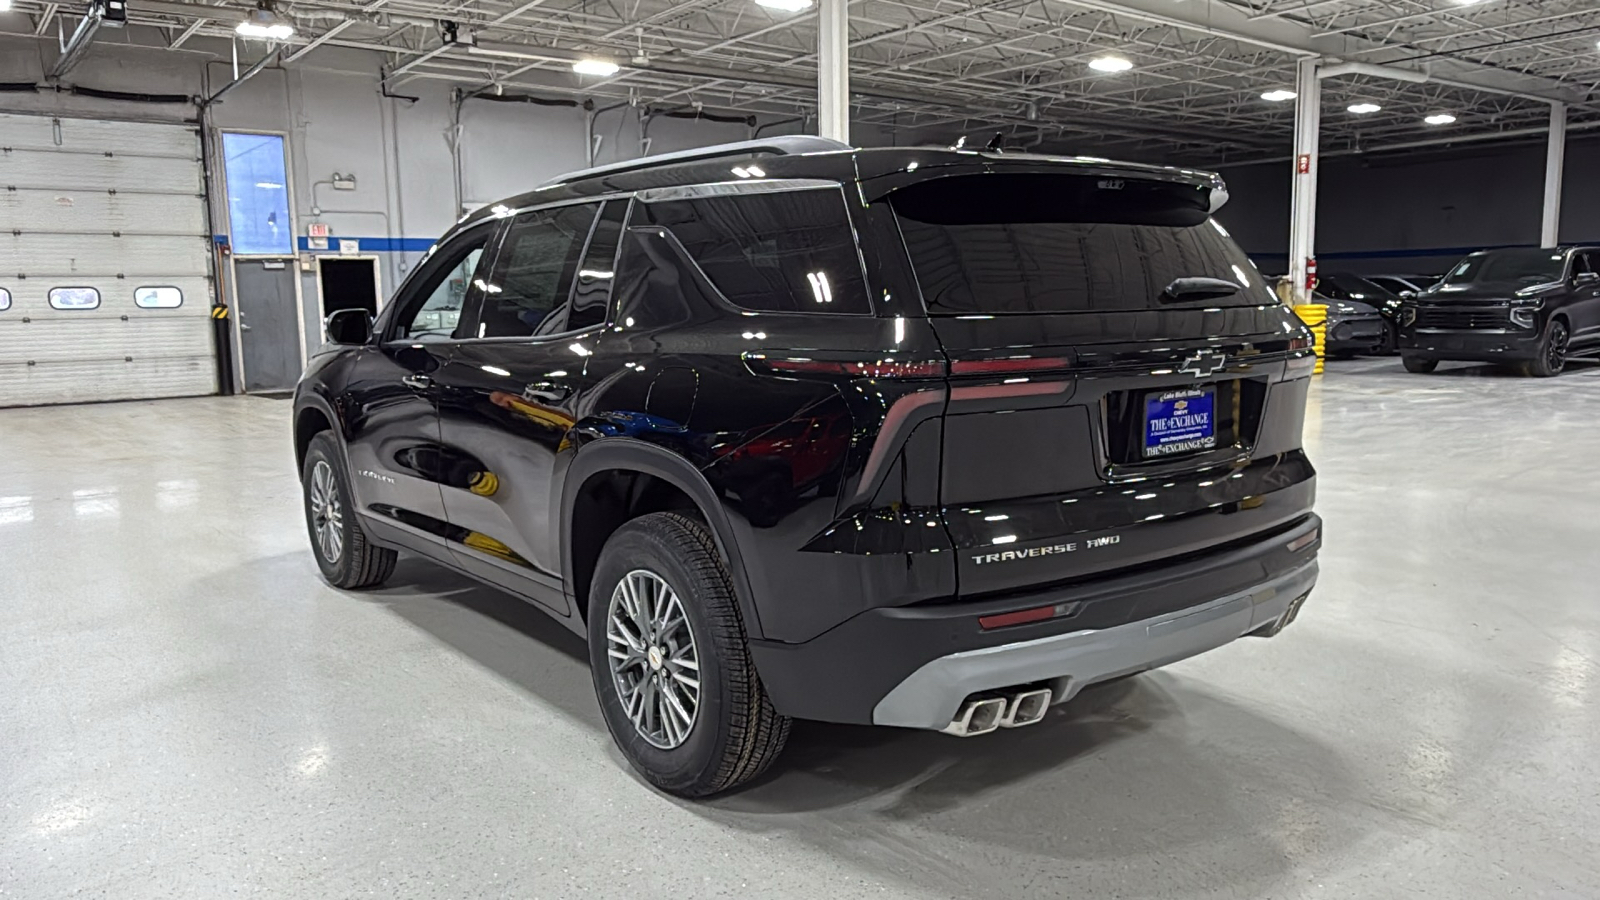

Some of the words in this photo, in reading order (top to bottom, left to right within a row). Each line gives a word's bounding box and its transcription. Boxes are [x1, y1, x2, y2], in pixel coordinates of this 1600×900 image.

[1150, 418, 1167, 431] THE
[1171, 413, 1208, 428] EXCHANGE
[1146, 447, 1160, 457] THE
[1165, 440, 1202, 453] EXCHANGE
[971, 543, 1077, 564] TRAVERSE
[1086, 534, 1120, 549] AWD
